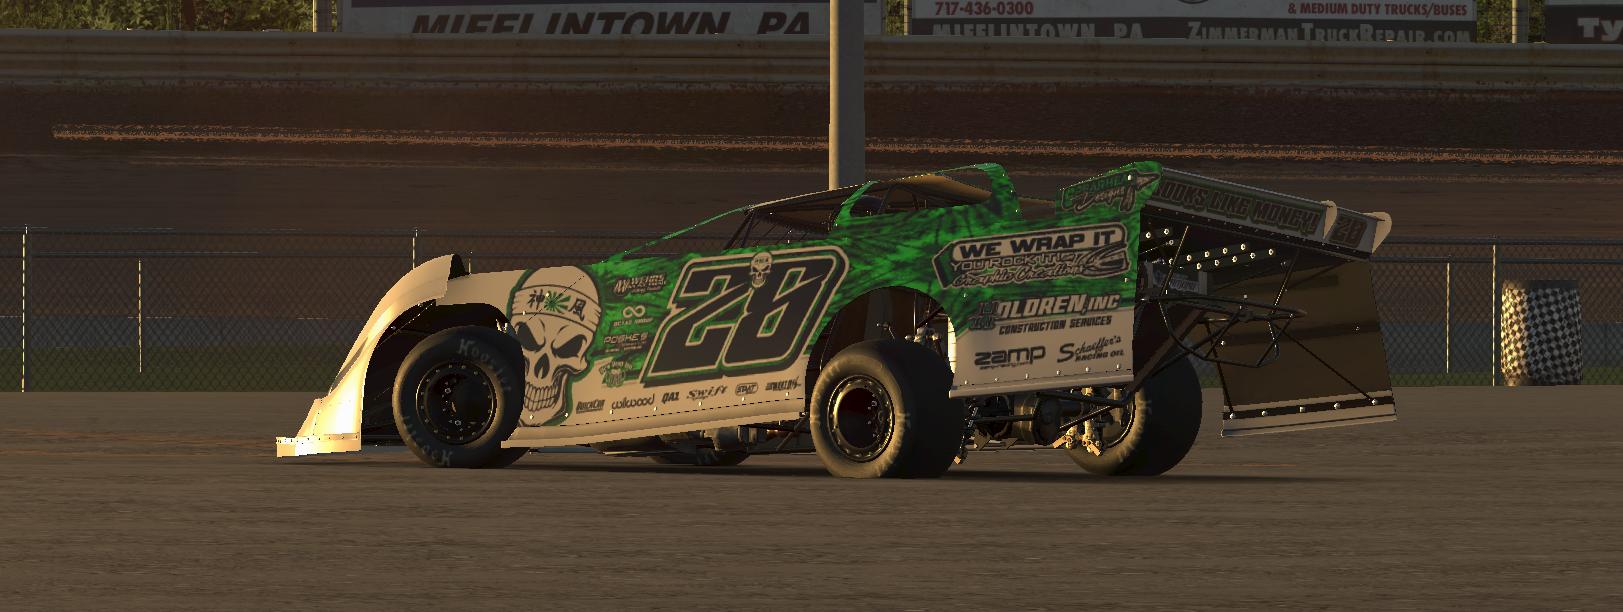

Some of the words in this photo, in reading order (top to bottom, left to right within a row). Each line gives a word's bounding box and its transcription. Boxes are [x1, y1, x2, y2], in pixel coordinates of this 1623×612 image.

[935, 2, 1033, 15] 717-436-0300
[1288, 3, 1296, 14] &
[1300, 3, 1348, 14] MEDIUM
[1351, 3, 1380, 15] DUTY
[1384, 3, 1467, 17] TRUCKS/BUSES
[757, 12, 810, 34] PA
[1113, 23, 1144, 39] PA
[960, 242, 1001, 259] WE
[1010, 233, 1085, 253] WRAP
[1093, 229, 1116, 246] IT
[527, 289, 545, 310] 神
[643, 248, 846, 384] 28
[999, 319, 1066, 335] CONSTRUCTION
[1069, 315, 1112, 329] SERVICES
[974, 345, 1046, 366] zamp
